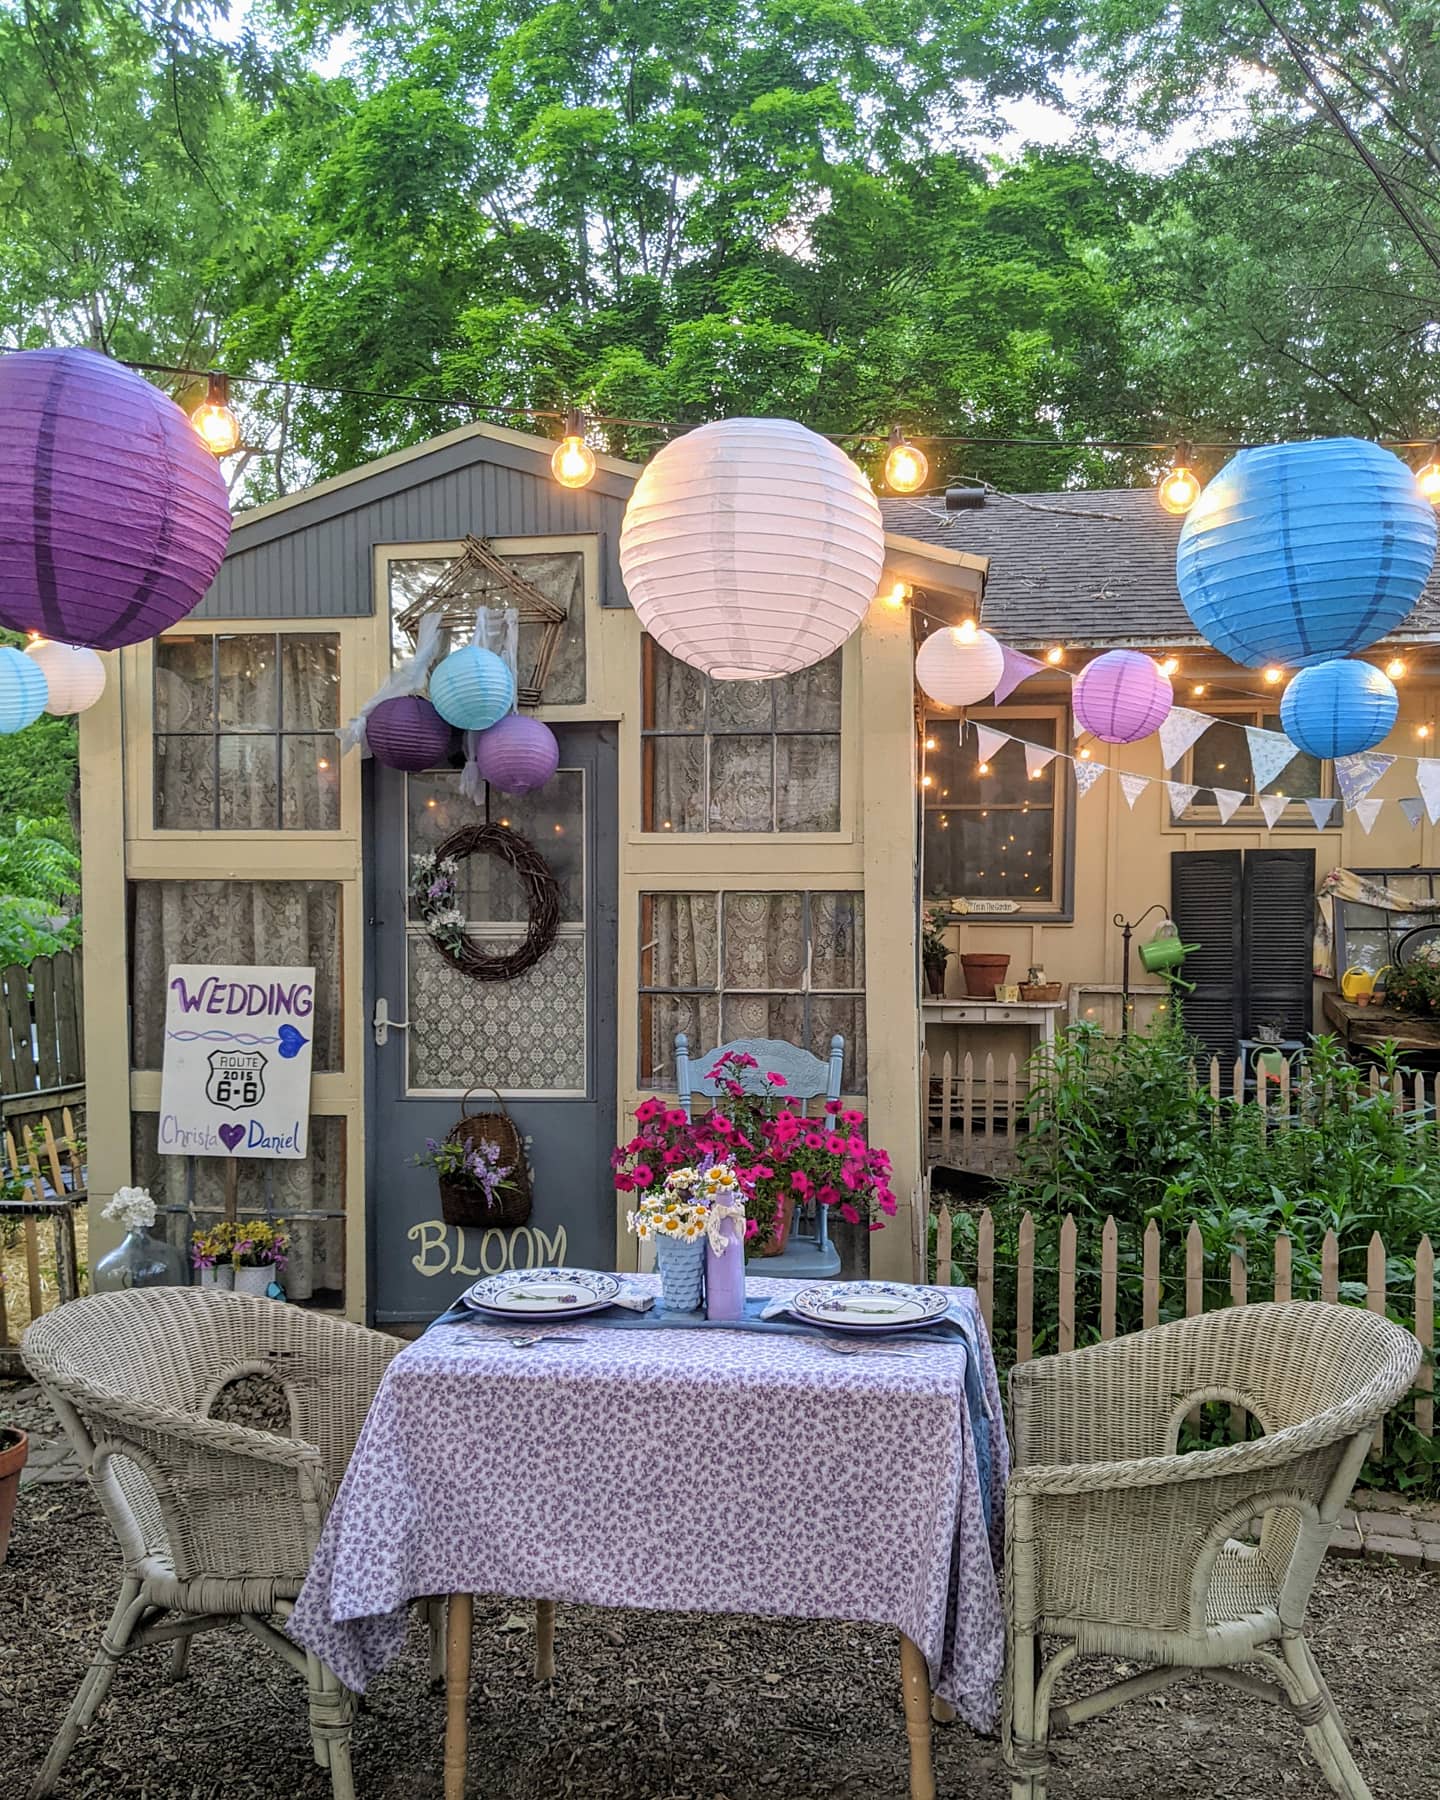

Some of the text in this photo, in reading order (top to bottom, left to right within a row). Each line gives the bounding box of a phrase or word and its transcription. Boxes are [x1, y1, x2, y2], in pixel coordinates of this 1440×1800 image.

[170, 976, 313, 1018] WEDDING
[219, 1056, 259, 1069] ROUTE
[223, 1070, 253, 1081] 2015
[216, 1081, 258, 1103] 6-6
[161, 1114, 301, 1154] Christa Daniel
[407, 1219, 567, 1277] BLOOM
